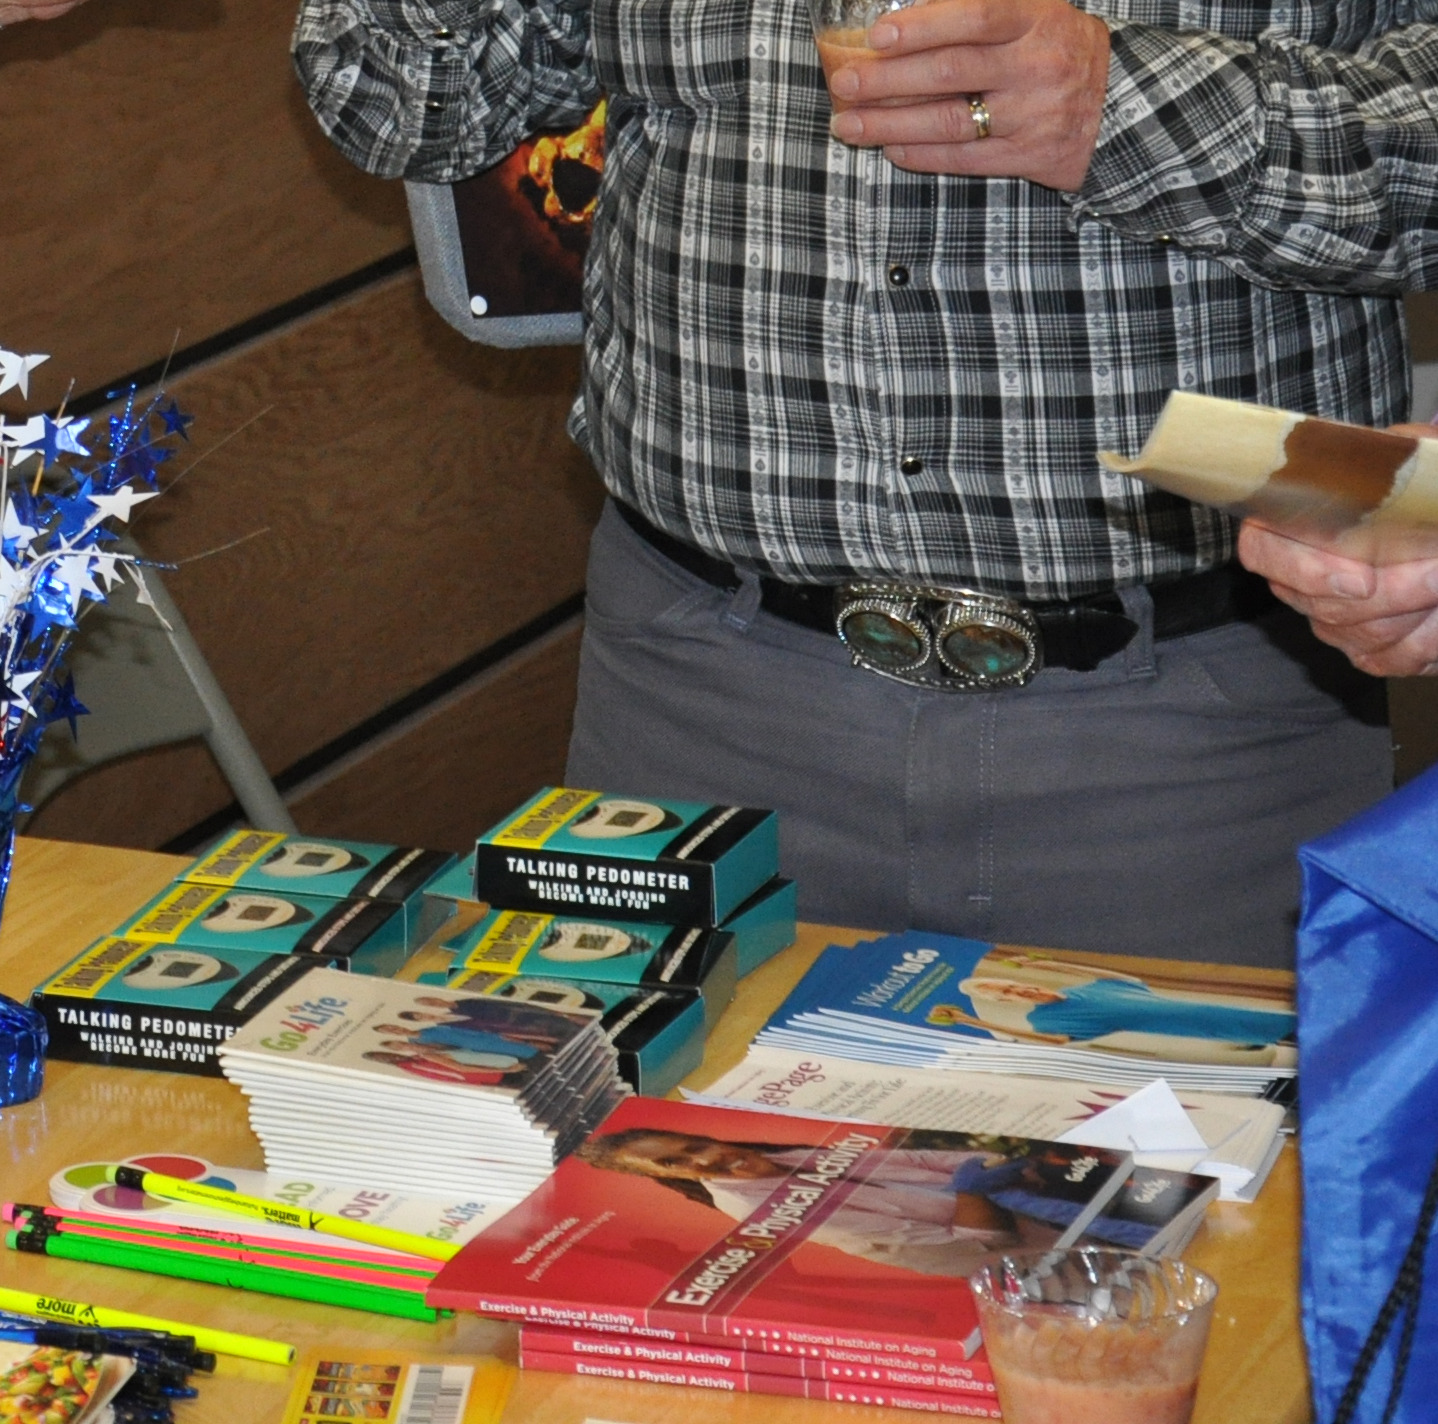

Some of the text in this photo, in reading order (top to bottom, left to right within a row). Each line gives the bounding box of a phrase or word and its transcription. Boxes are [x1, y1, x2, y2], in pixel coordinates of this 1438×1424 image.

[506, 856, 690, 891] TALKING PEDOMETER
[528, 879, 667, 904] WALKING AND JOGGING
[538, 889, 650, 910] BECOME MORE FUN
[902, 948, 941, 964] Go
[57, 1007, 133, 1031] TALKING
[259, 996, 350, 1052] Go4Life
[79, 1032, 134, 1047] WALKING
[139, 1038, 164, 1050] AND
[90, 1040, 206, 1063] BECOME MORE FUN
[665, 1246, 756, 1308] Exercise
[740, 1180, 822, 1241] Physical
[803, 1131, 881, 1188] Activity
[35, 1298, 77, 1317] more
[479, 1300, 635, 1327] Exercise & Physical Activity
[632, 1326, 676, 1341] Activity
[787, 1330, 937, 1357] National Institute on Aging
[572, 1341, 732, 1368] Exercise & Physical Activity
[825, 1348, 973, 1378] National Institute on Aging
[576, 1362, 736, 1391] Exercise & Physical Activity
[887, 1371, 996, 1392] National Institute o
[891, 1397, 938, 1412] National
[940, 1402, 987, 1417] Institute
